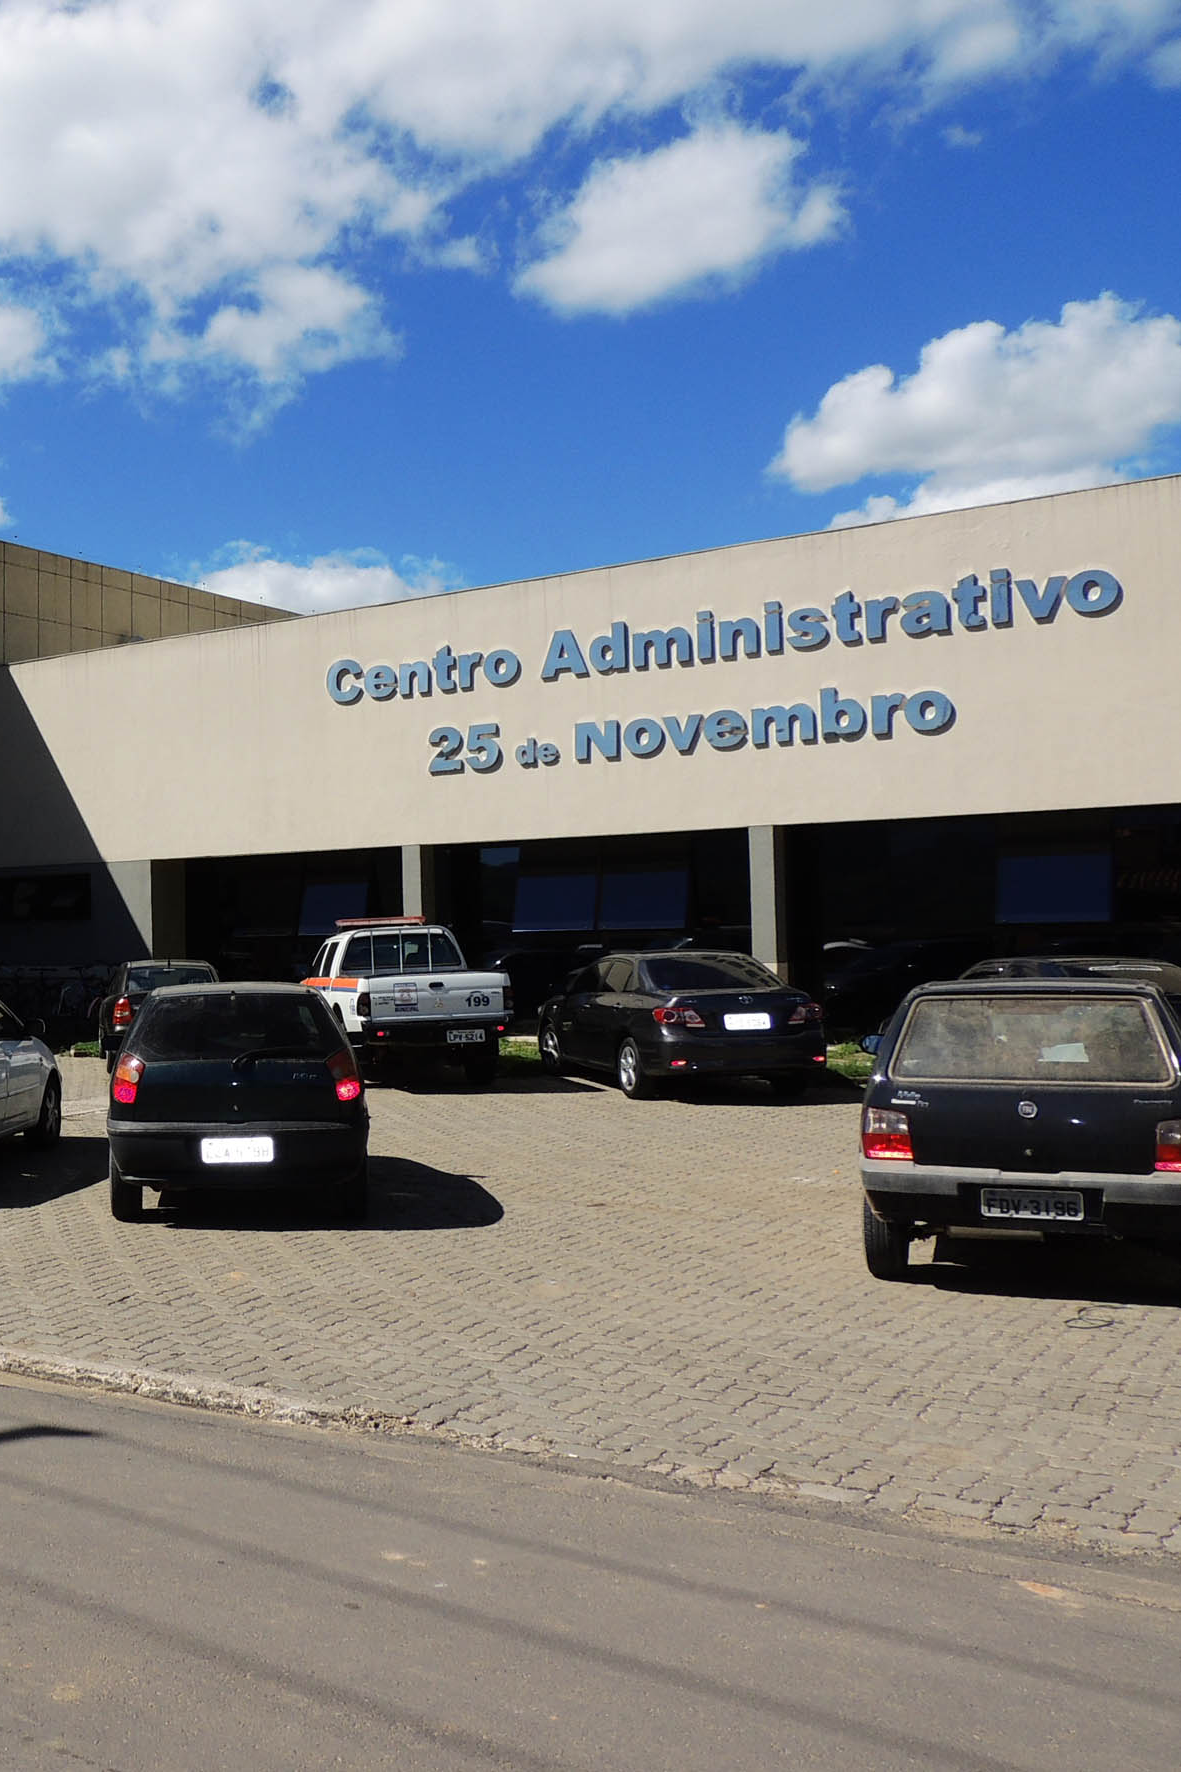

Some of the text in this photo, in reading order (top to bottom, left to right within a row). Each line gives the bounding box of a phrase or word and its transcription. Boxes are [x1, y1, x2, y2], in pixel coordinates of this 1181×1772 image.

[327, 568, 1123, 706] Centro Administrativo
[429, 686, 956, 776] 25 de Novembro
[465, 995, 490, 1007] 199
